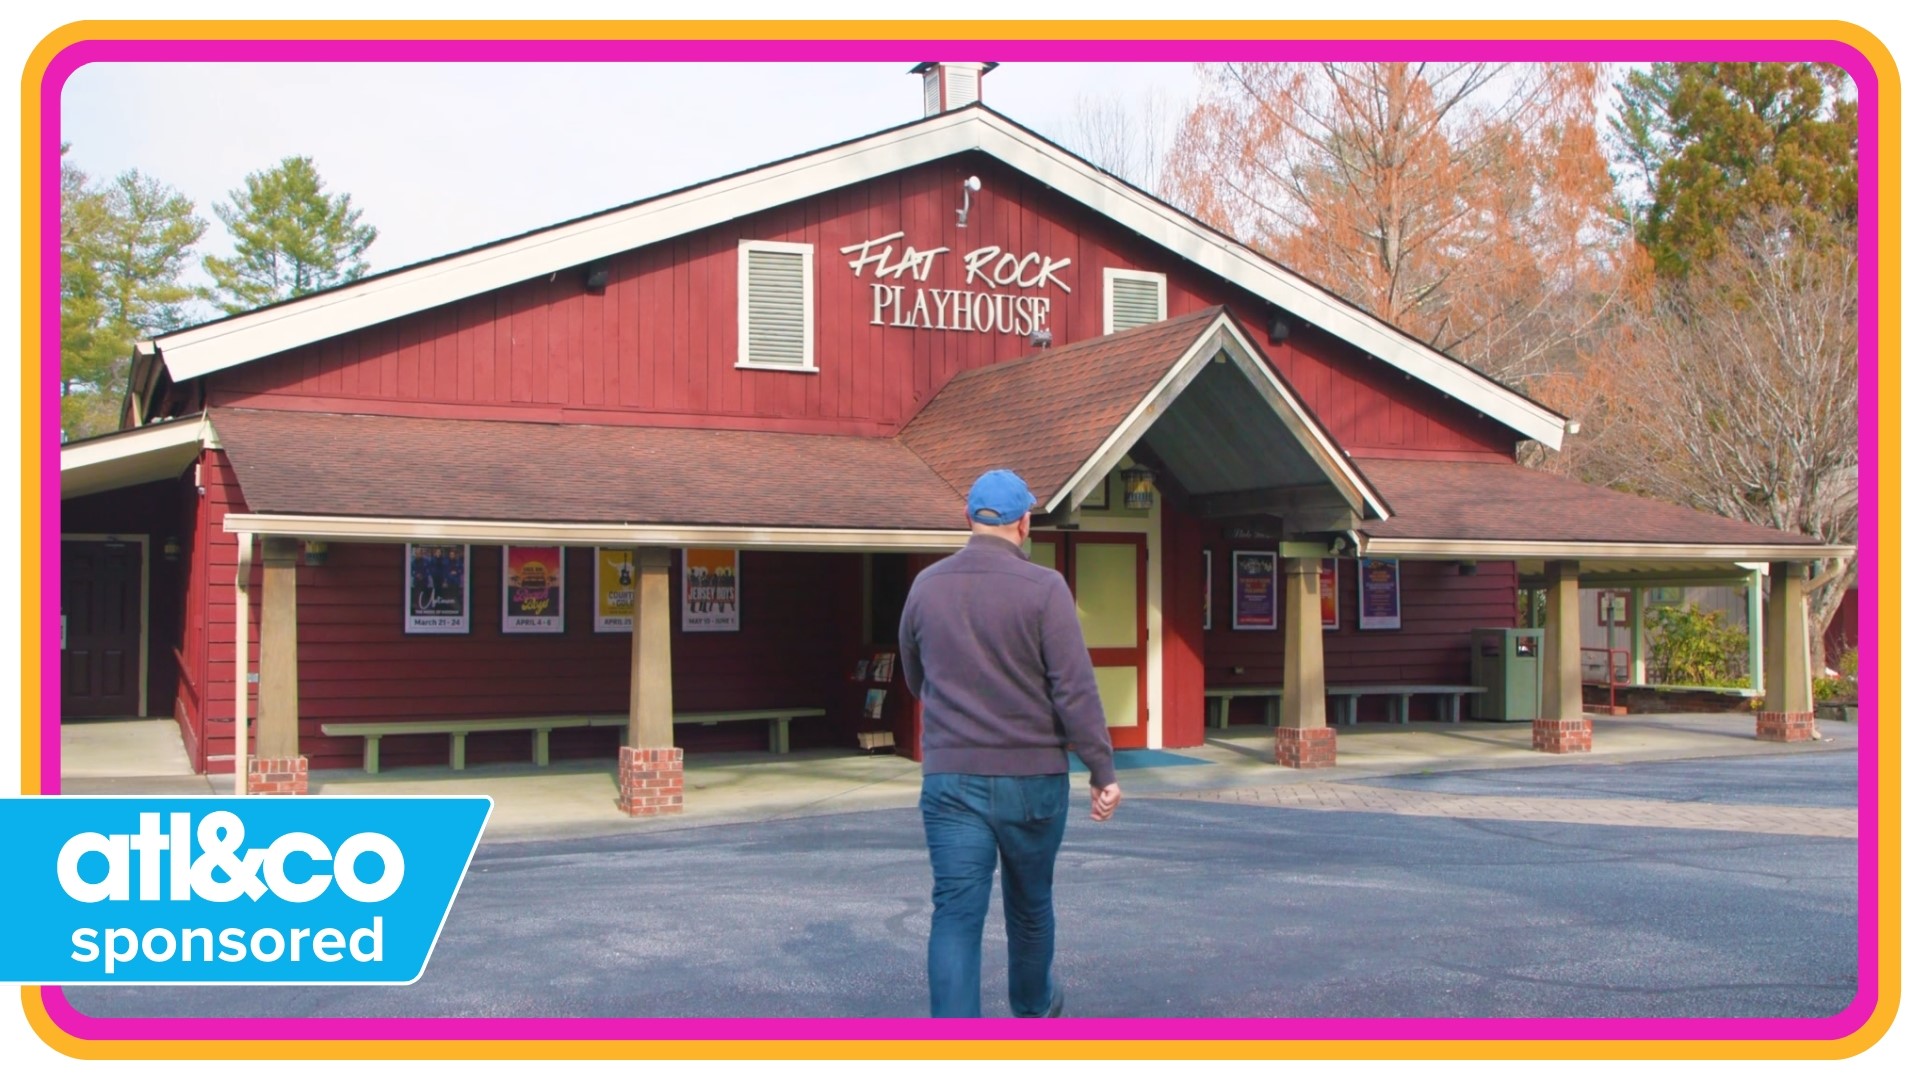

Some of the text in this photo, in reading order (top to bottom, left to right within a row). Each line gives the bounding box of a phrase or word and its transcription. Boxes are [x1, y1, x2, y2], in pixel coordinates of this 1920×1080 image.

[840, 231, 1071, 293] FLAT ROCK
[869, 283, 1050, 336] PLAYHOUSE
[687, 587, 715, 601] JERSEY
